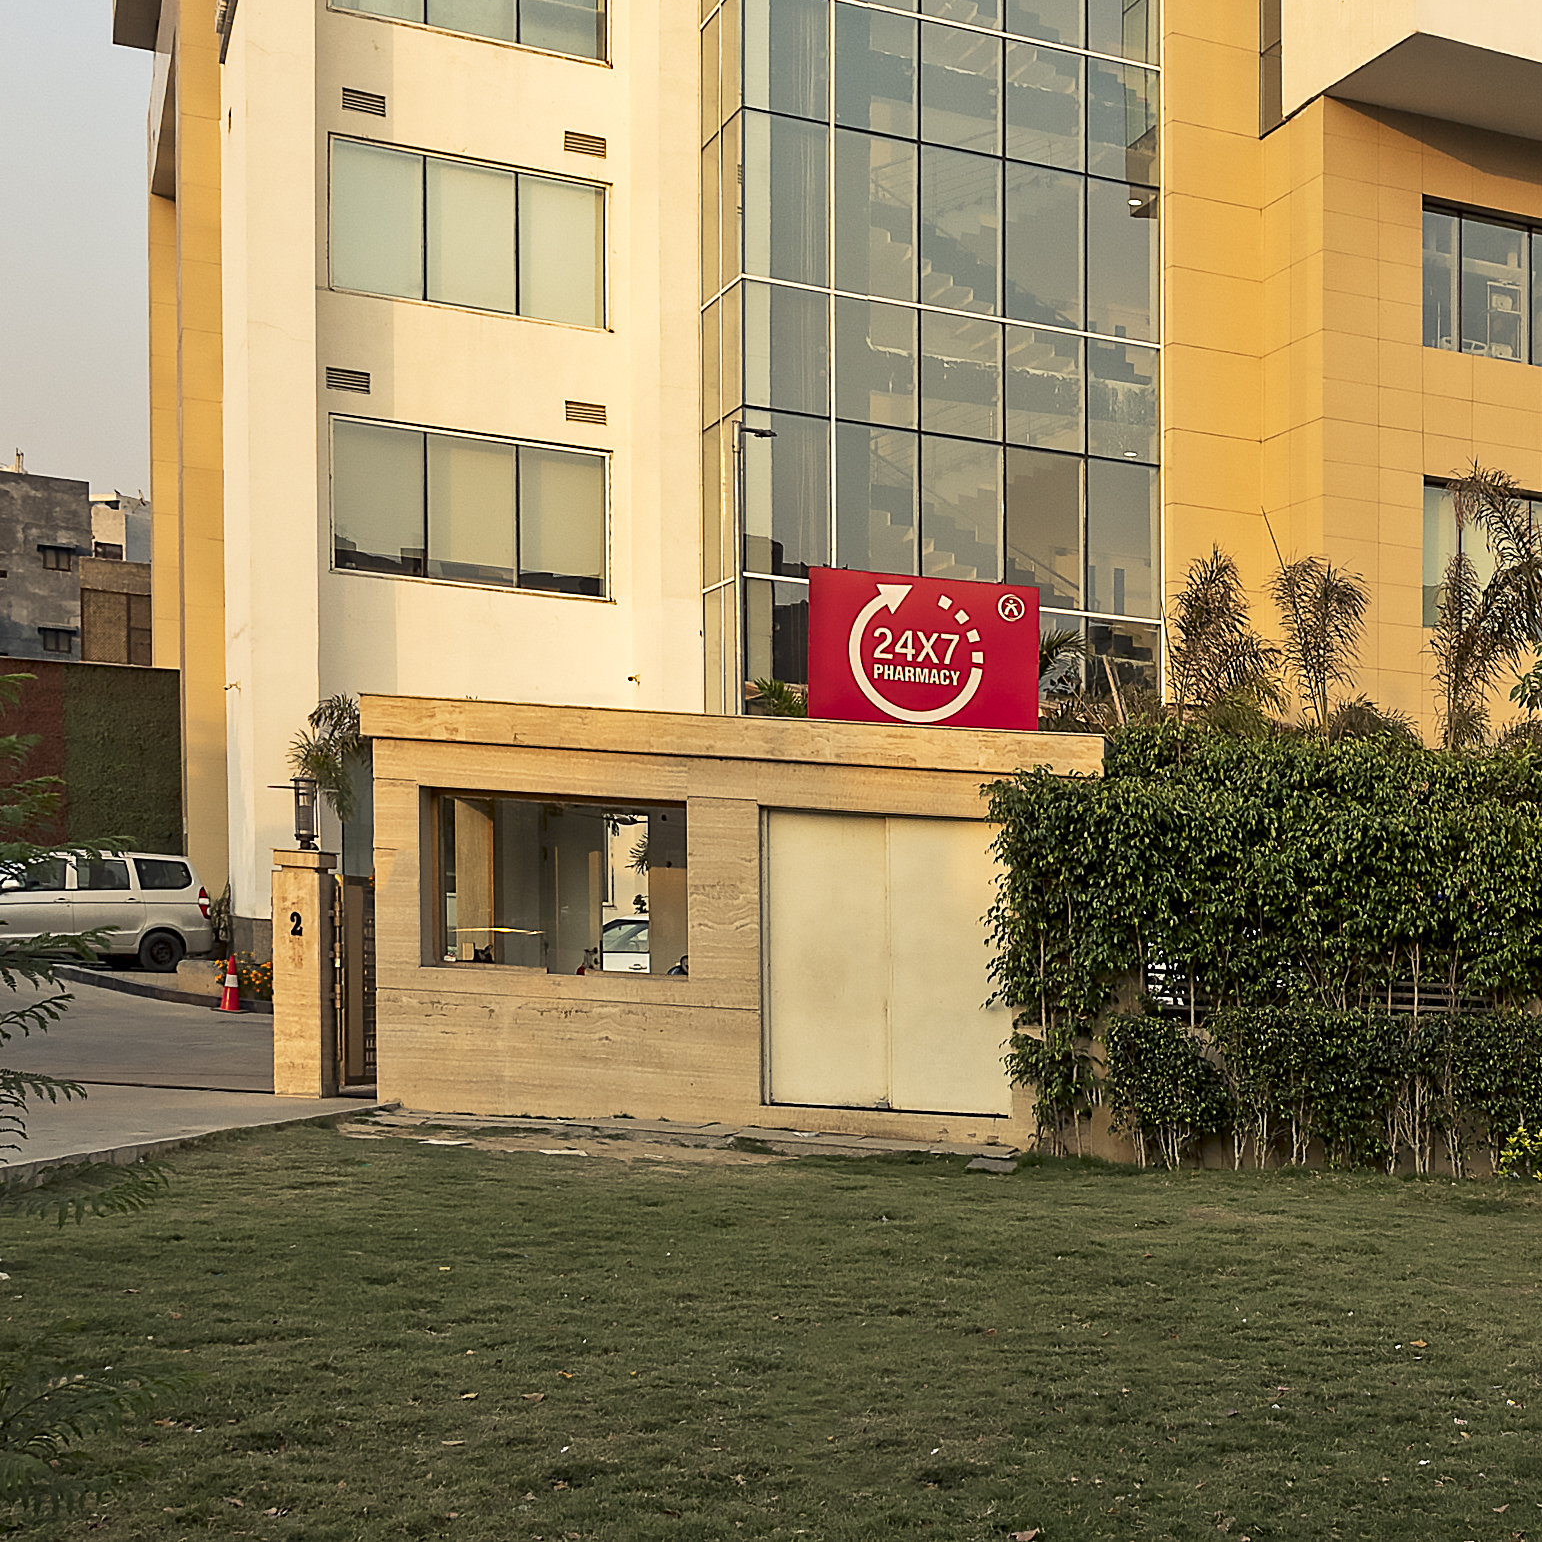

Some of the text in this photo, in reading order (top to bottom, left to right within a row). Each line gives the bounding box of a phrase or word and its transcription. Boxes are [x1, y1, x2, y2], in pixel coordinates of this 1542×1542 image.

[873, 627, 960, 666] 24X7
[873, 663, 960, 686] PHARMACY
[289, 911, 304, 936] 2
